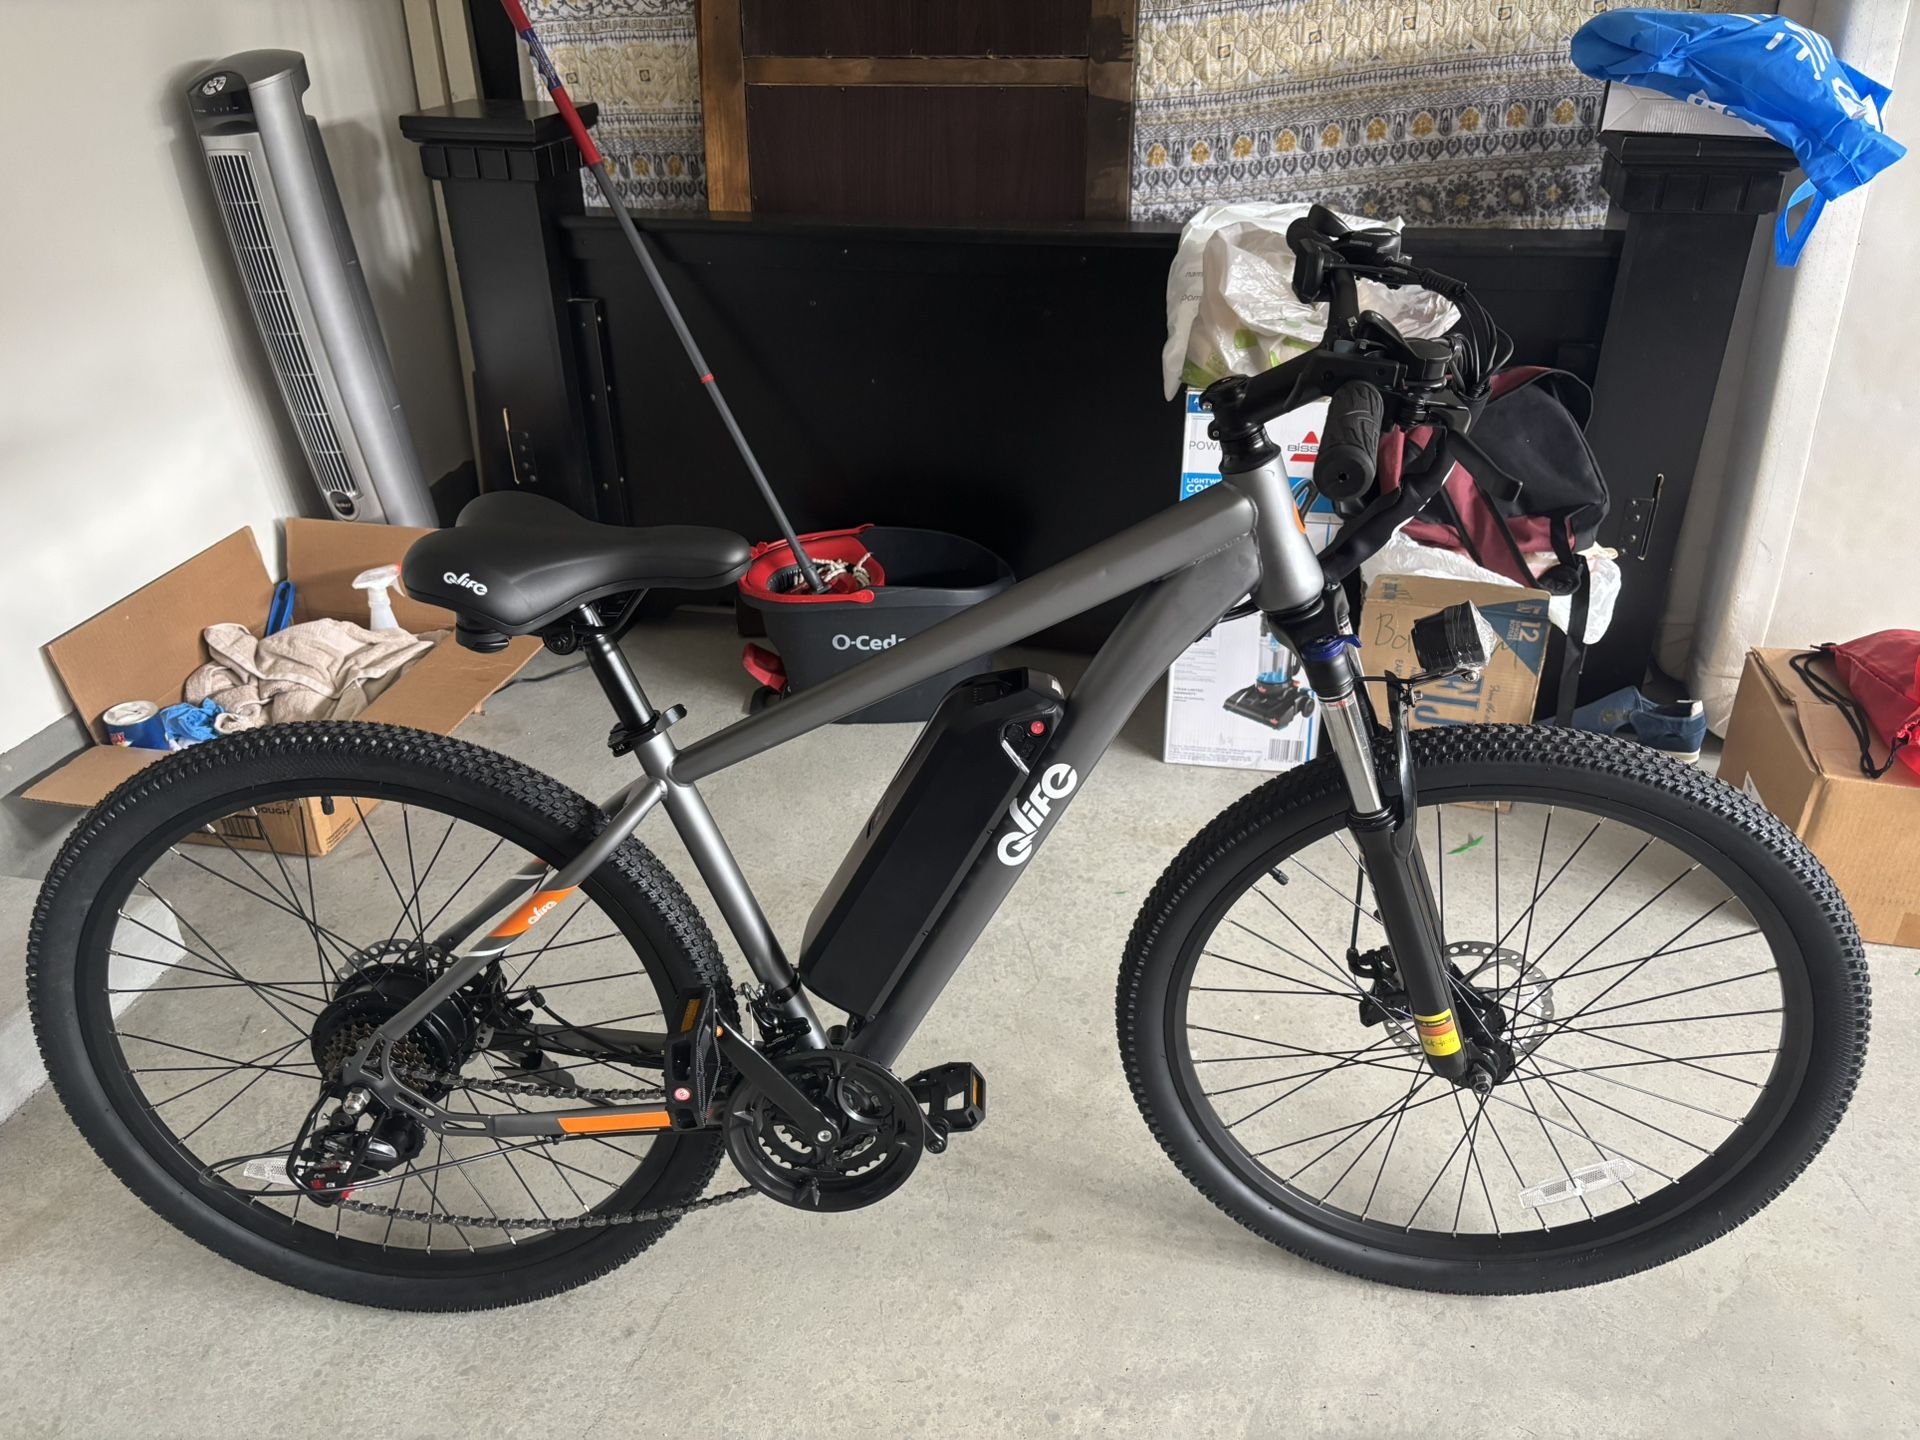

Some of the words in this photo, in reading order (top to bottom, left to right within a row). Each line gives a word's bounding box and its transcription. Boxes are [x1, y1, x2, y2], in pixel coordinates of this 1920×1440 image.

[1287, 443, 1319, 453] BISS
[832, 634, 906, 650] O-Ced
[1414, 674, 1484, 727] FIJ
